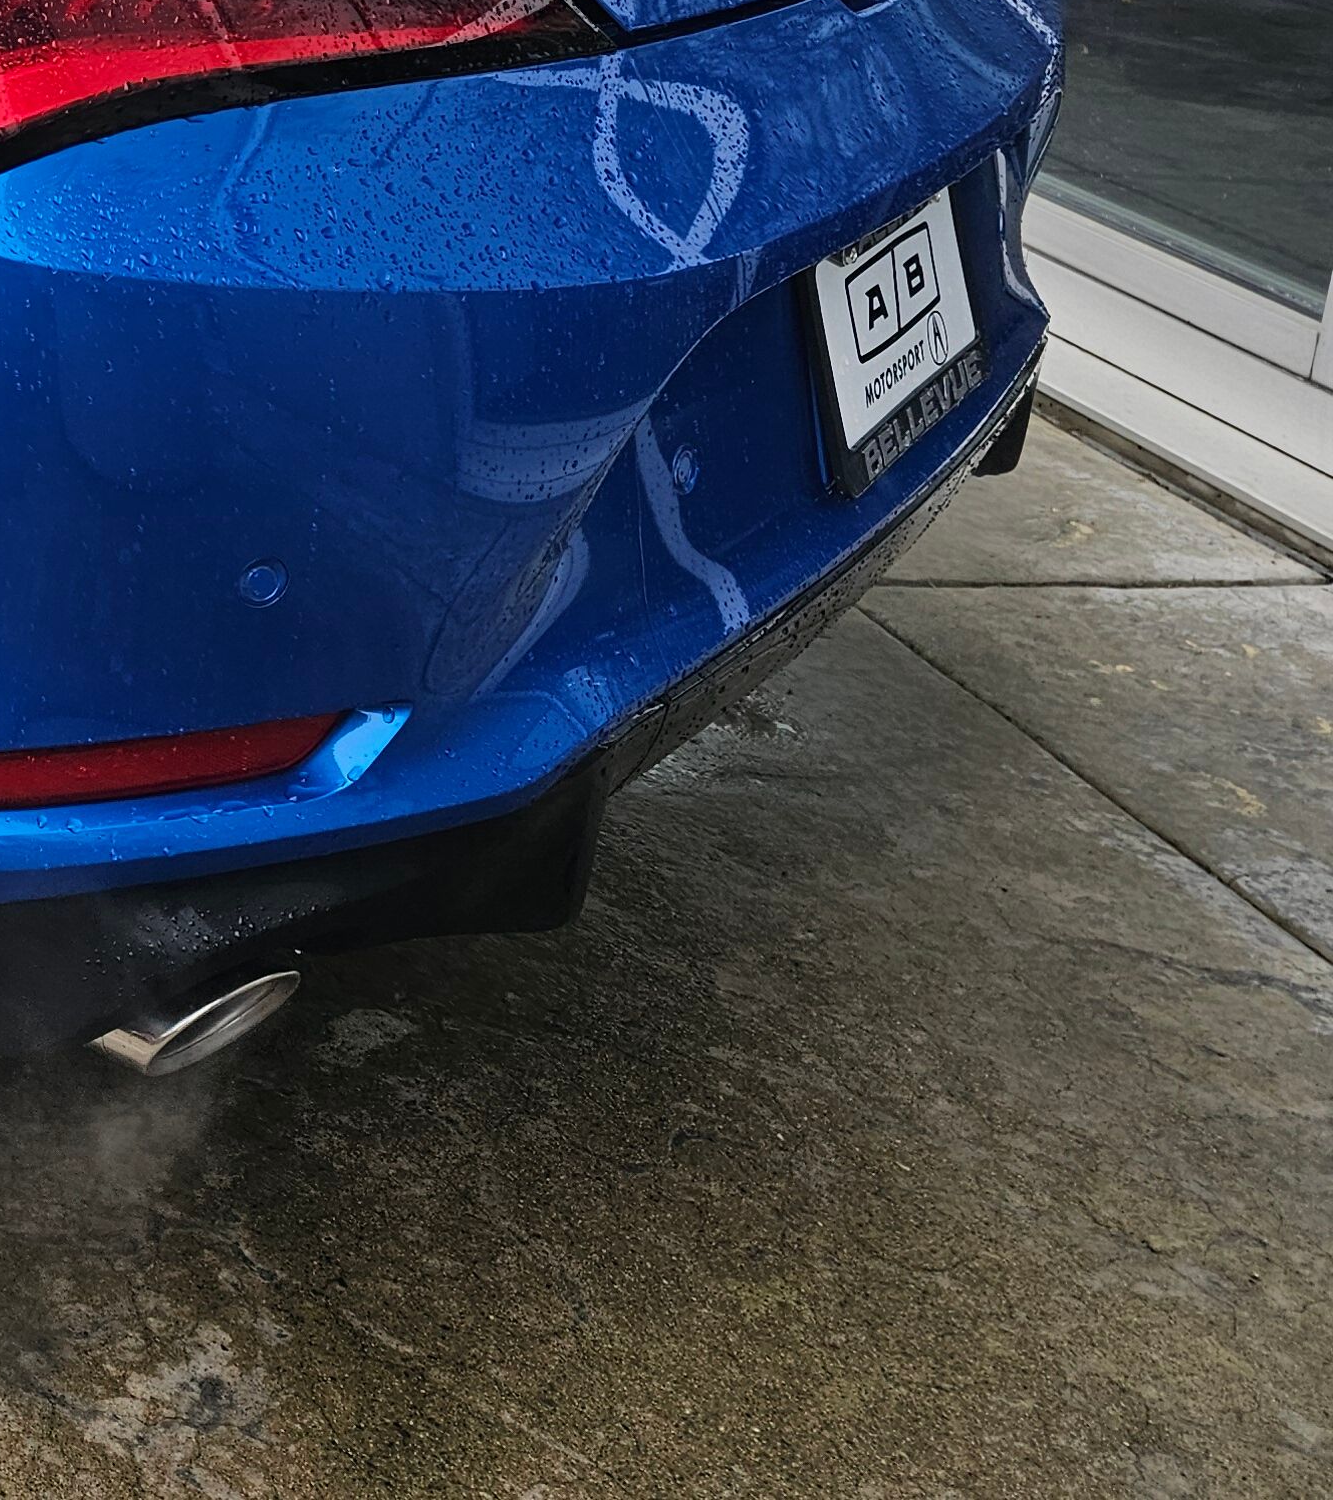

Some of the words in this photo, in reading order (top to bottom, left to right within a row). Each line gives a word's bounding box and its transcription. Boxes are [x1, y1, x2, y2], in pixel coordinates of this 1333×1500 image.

[865, 284, 888, 331] A
[902, 253, 925, 298] B
[864, 340, 926, 409] MOTORSPORT
[861, 350, 987, 482] BELLEVUE
